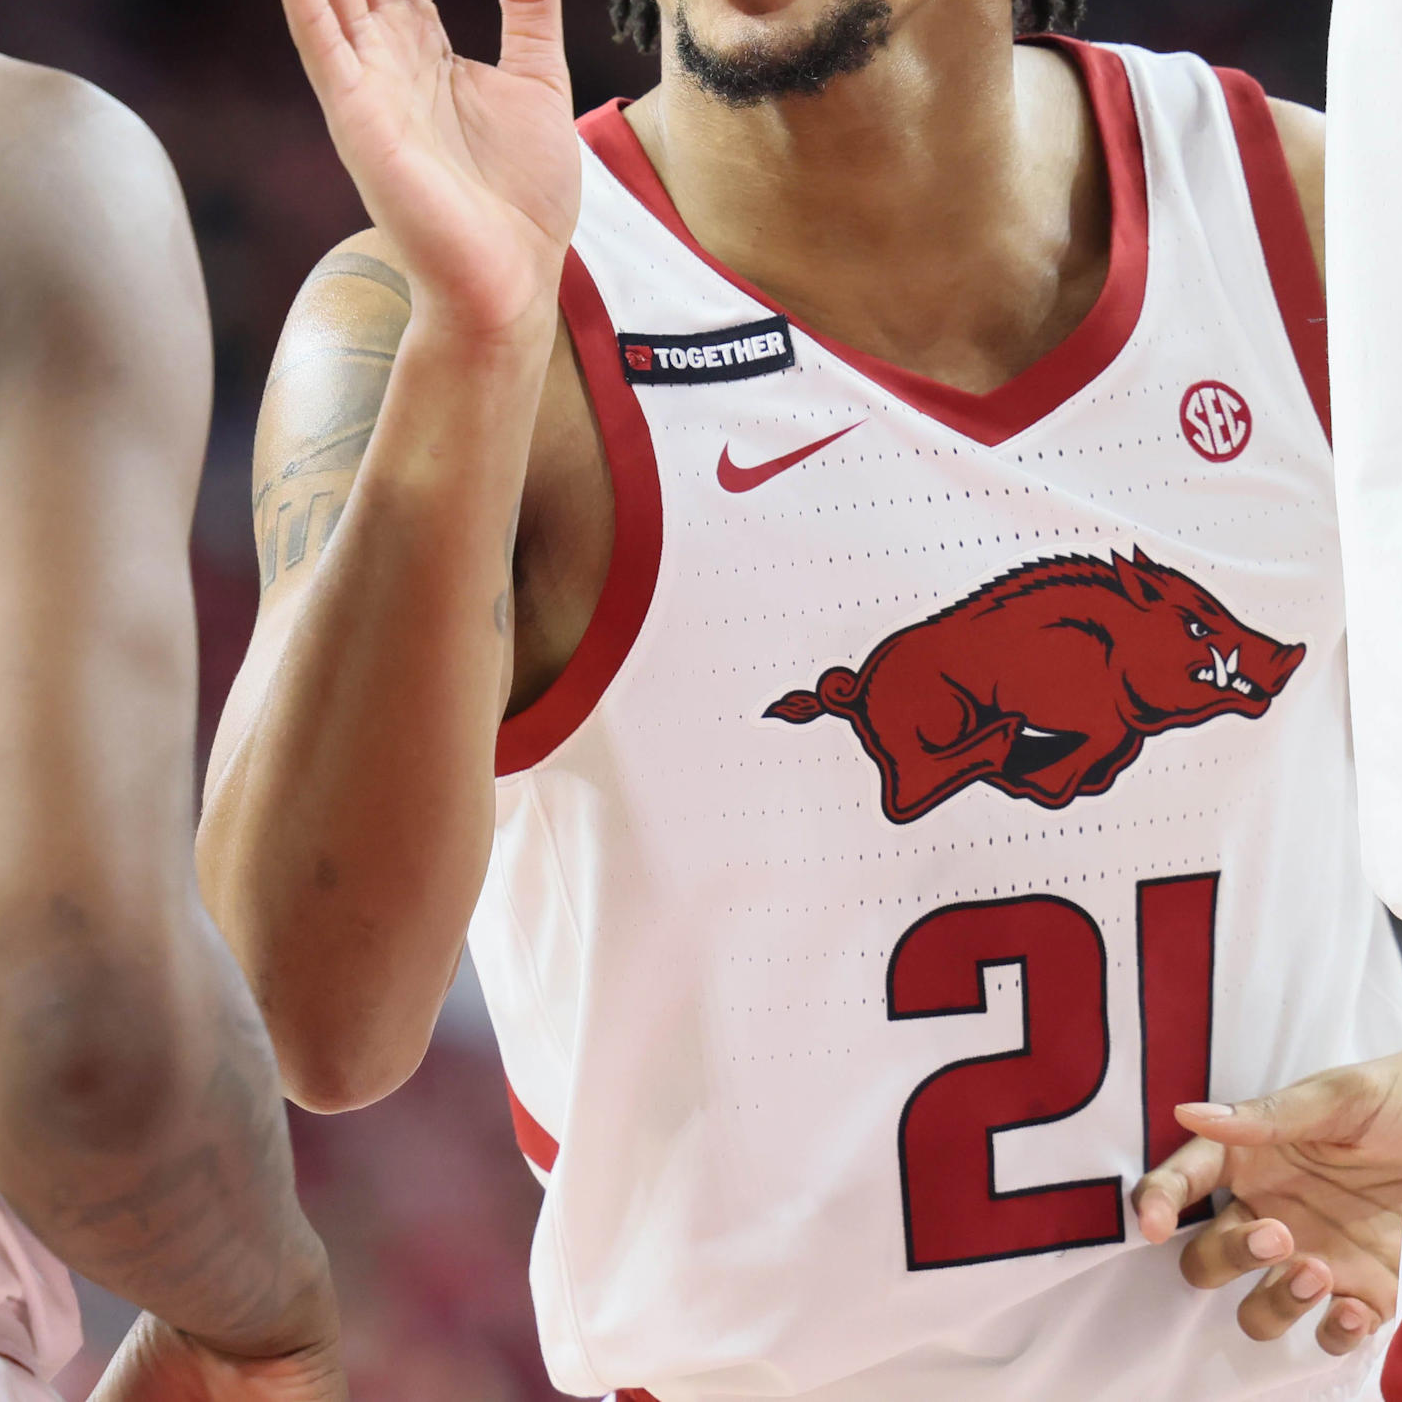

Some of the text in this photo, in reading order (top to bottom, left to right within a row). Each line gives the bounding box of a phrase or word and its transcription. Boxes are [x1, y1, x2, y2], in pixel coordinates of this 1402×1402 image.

[653, 331, 787, 370] TOGETHER
[1185, 387, 1247, 455] SEC
[887, 870, 1221, 1271] 21
